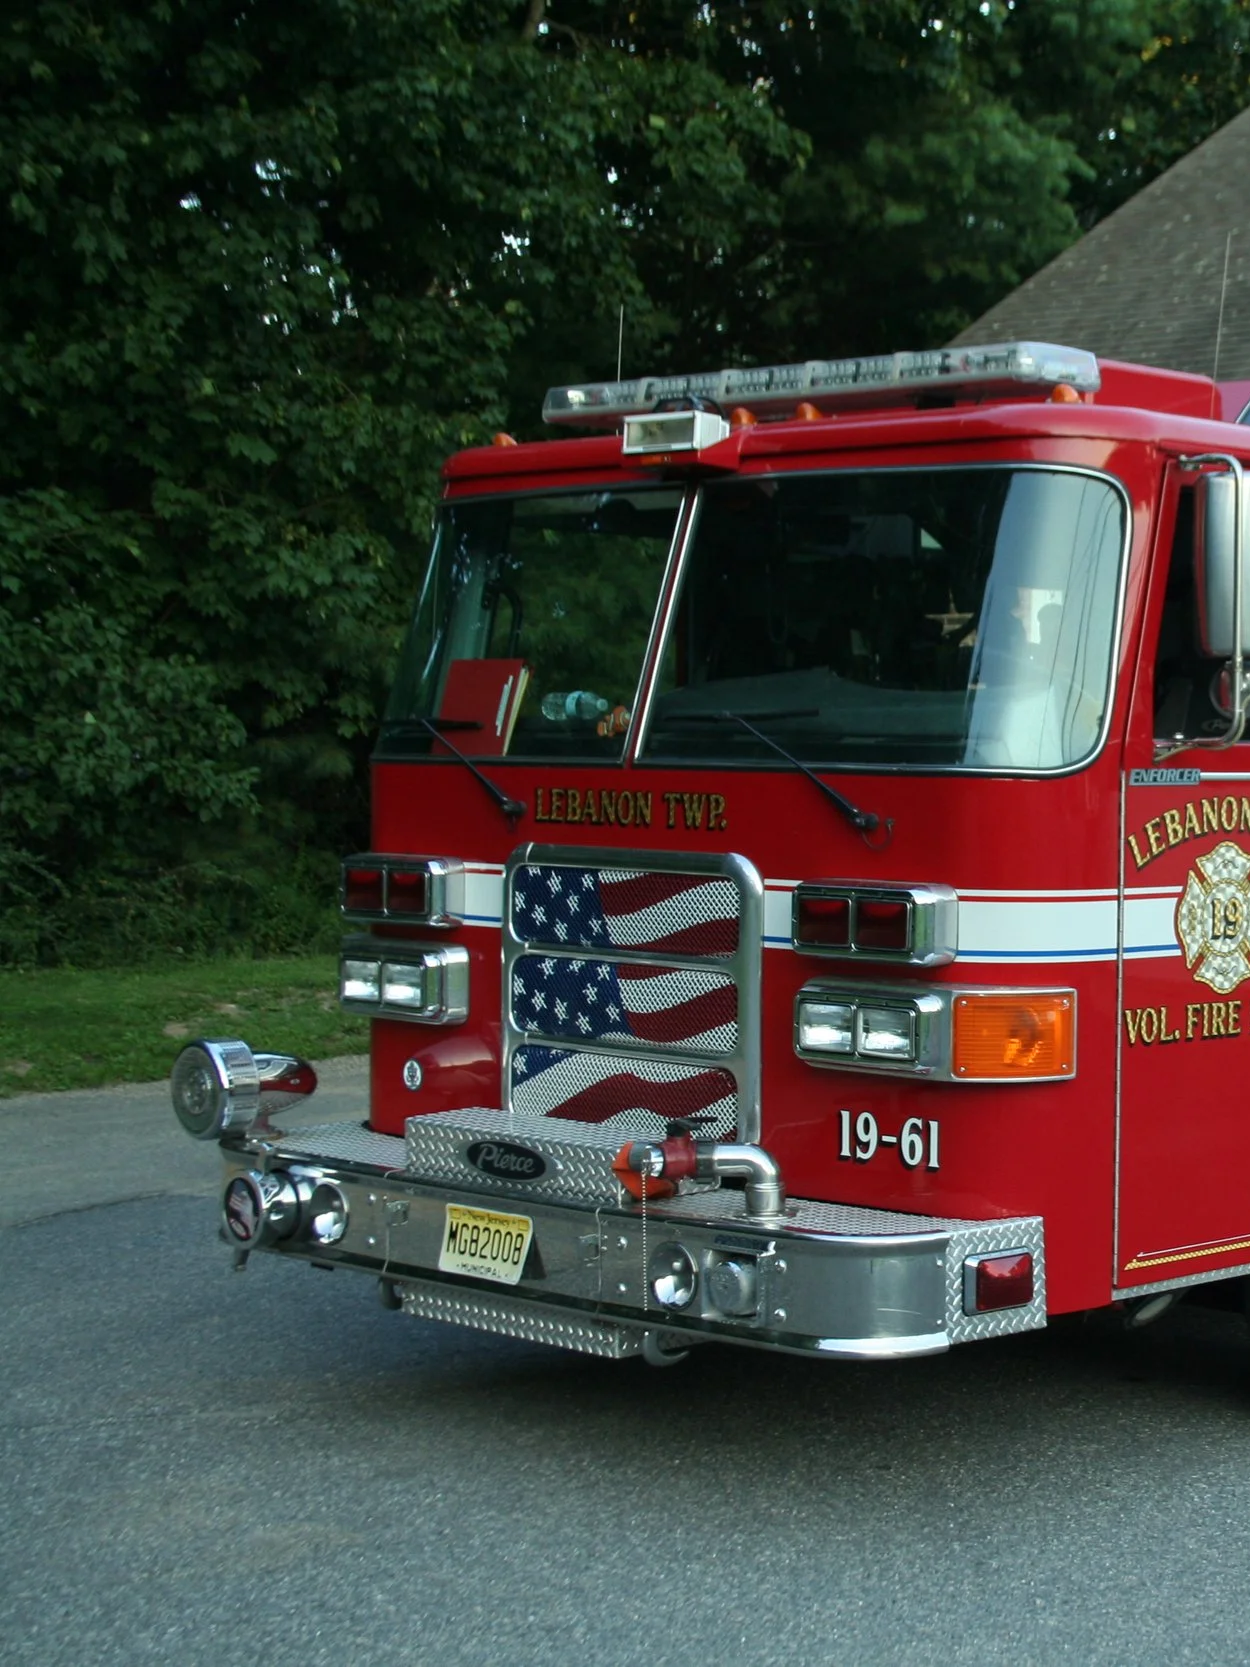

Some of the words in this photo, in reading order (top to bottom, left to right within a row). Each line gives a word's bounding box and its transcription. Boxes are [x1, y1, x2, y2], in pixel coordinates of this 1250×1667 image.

[1131, 768, 1201, 784] ENFORCER
[535, 788, 652, 826] LEBANON
[664, 792, 728, 830] TWP.
[1211, 897, 1243, 940] 19
[1125, 1007, 1181, 1045] VOL.
[1186, 1001, 1242, 1039] FIRE
[839, 1110, 940, 1169] 19-61
[476, 1143, 535, 1173] Pierce
[466, 1209, 486, 1222] New
[486, 1213, 511, 1228] Jersey
[460, 1262, 502, 1279] MUNICIPAL
